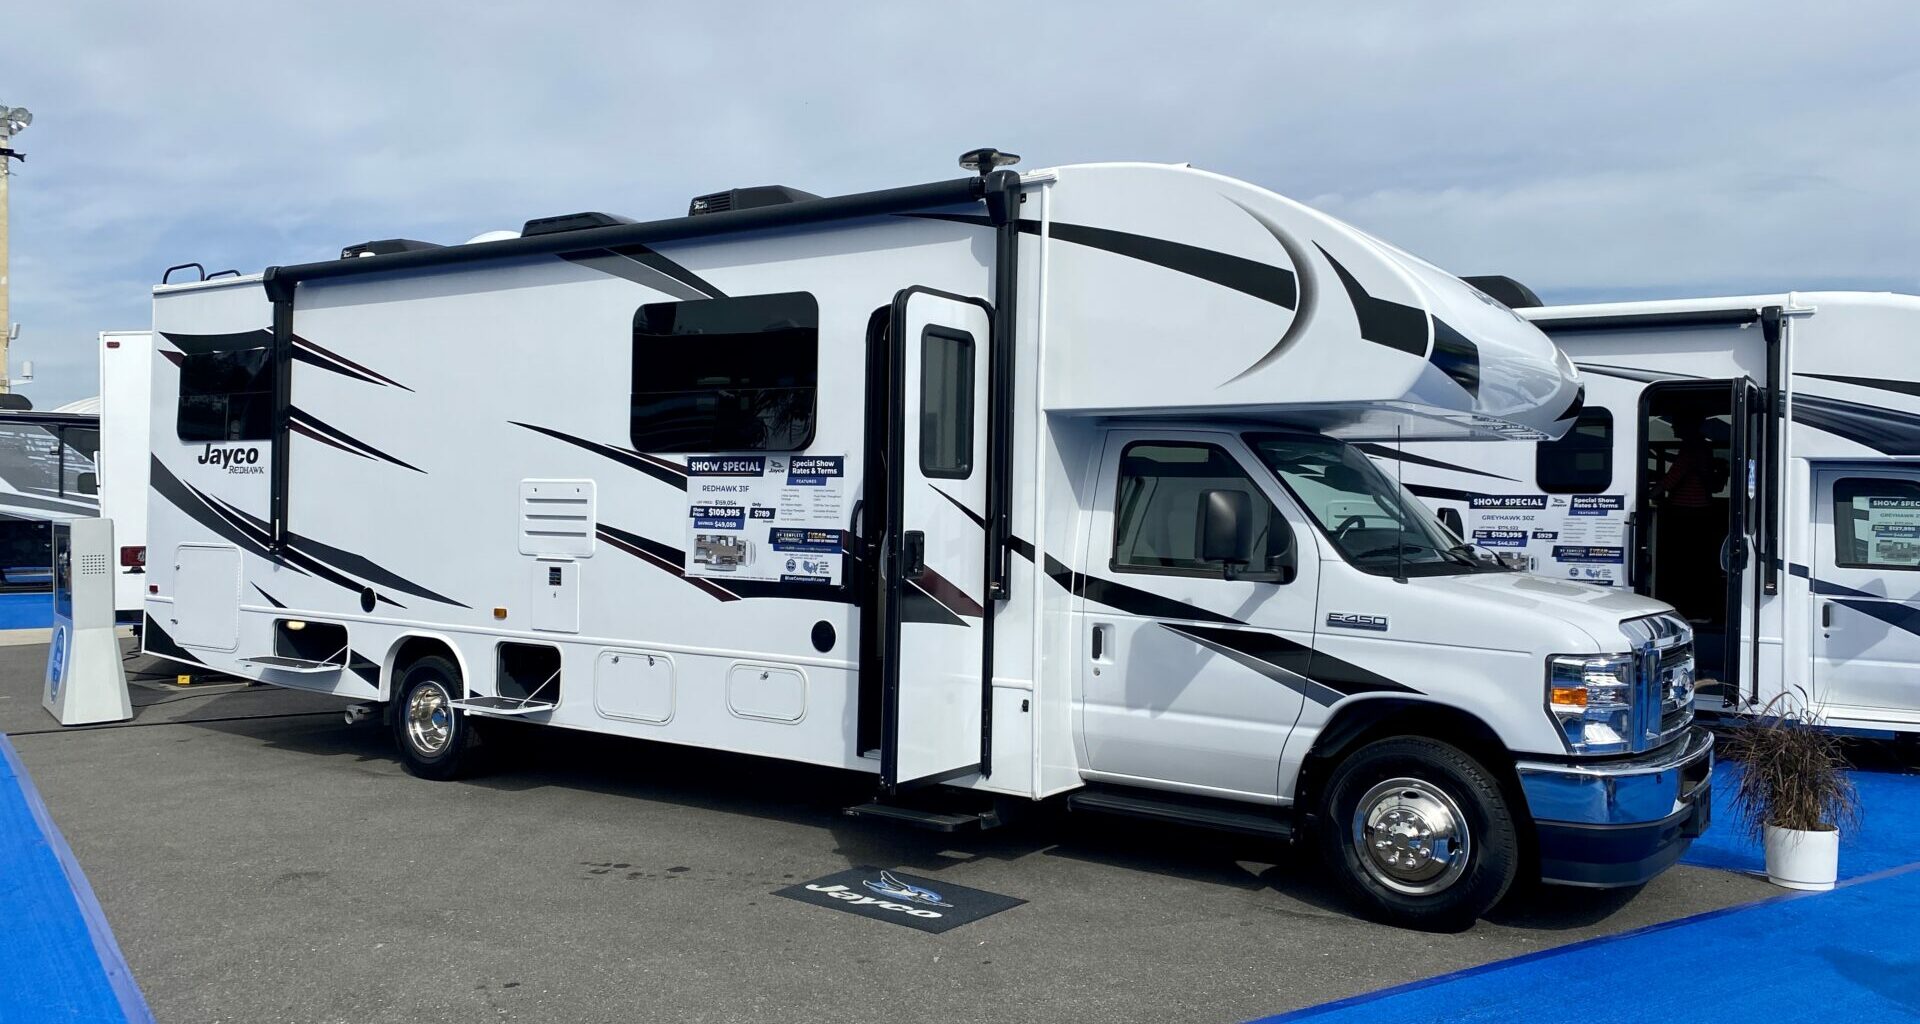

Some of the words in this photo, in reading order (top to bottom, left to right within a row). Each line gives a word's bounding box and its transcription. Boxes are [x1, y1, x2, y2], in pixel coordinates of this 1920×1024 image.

[197, 443, 259, 469] Jayco
[691, 461, 720, 472] SHOW
[722, 461, 761, 472] SPECIAL
[792, 460, 815, 468] Special
[702, 484, 737, 492] REDHAWK
[738, 485, 750, 493] 31F
[1473, 498, 1503, 506] SHOW
[1504, 498, 1544, 506] SPECIAL
[708, 507, 741, 517] $109,995
[754, 510, 771, 518] $789
[805, 883, 943, 919] Jayco
